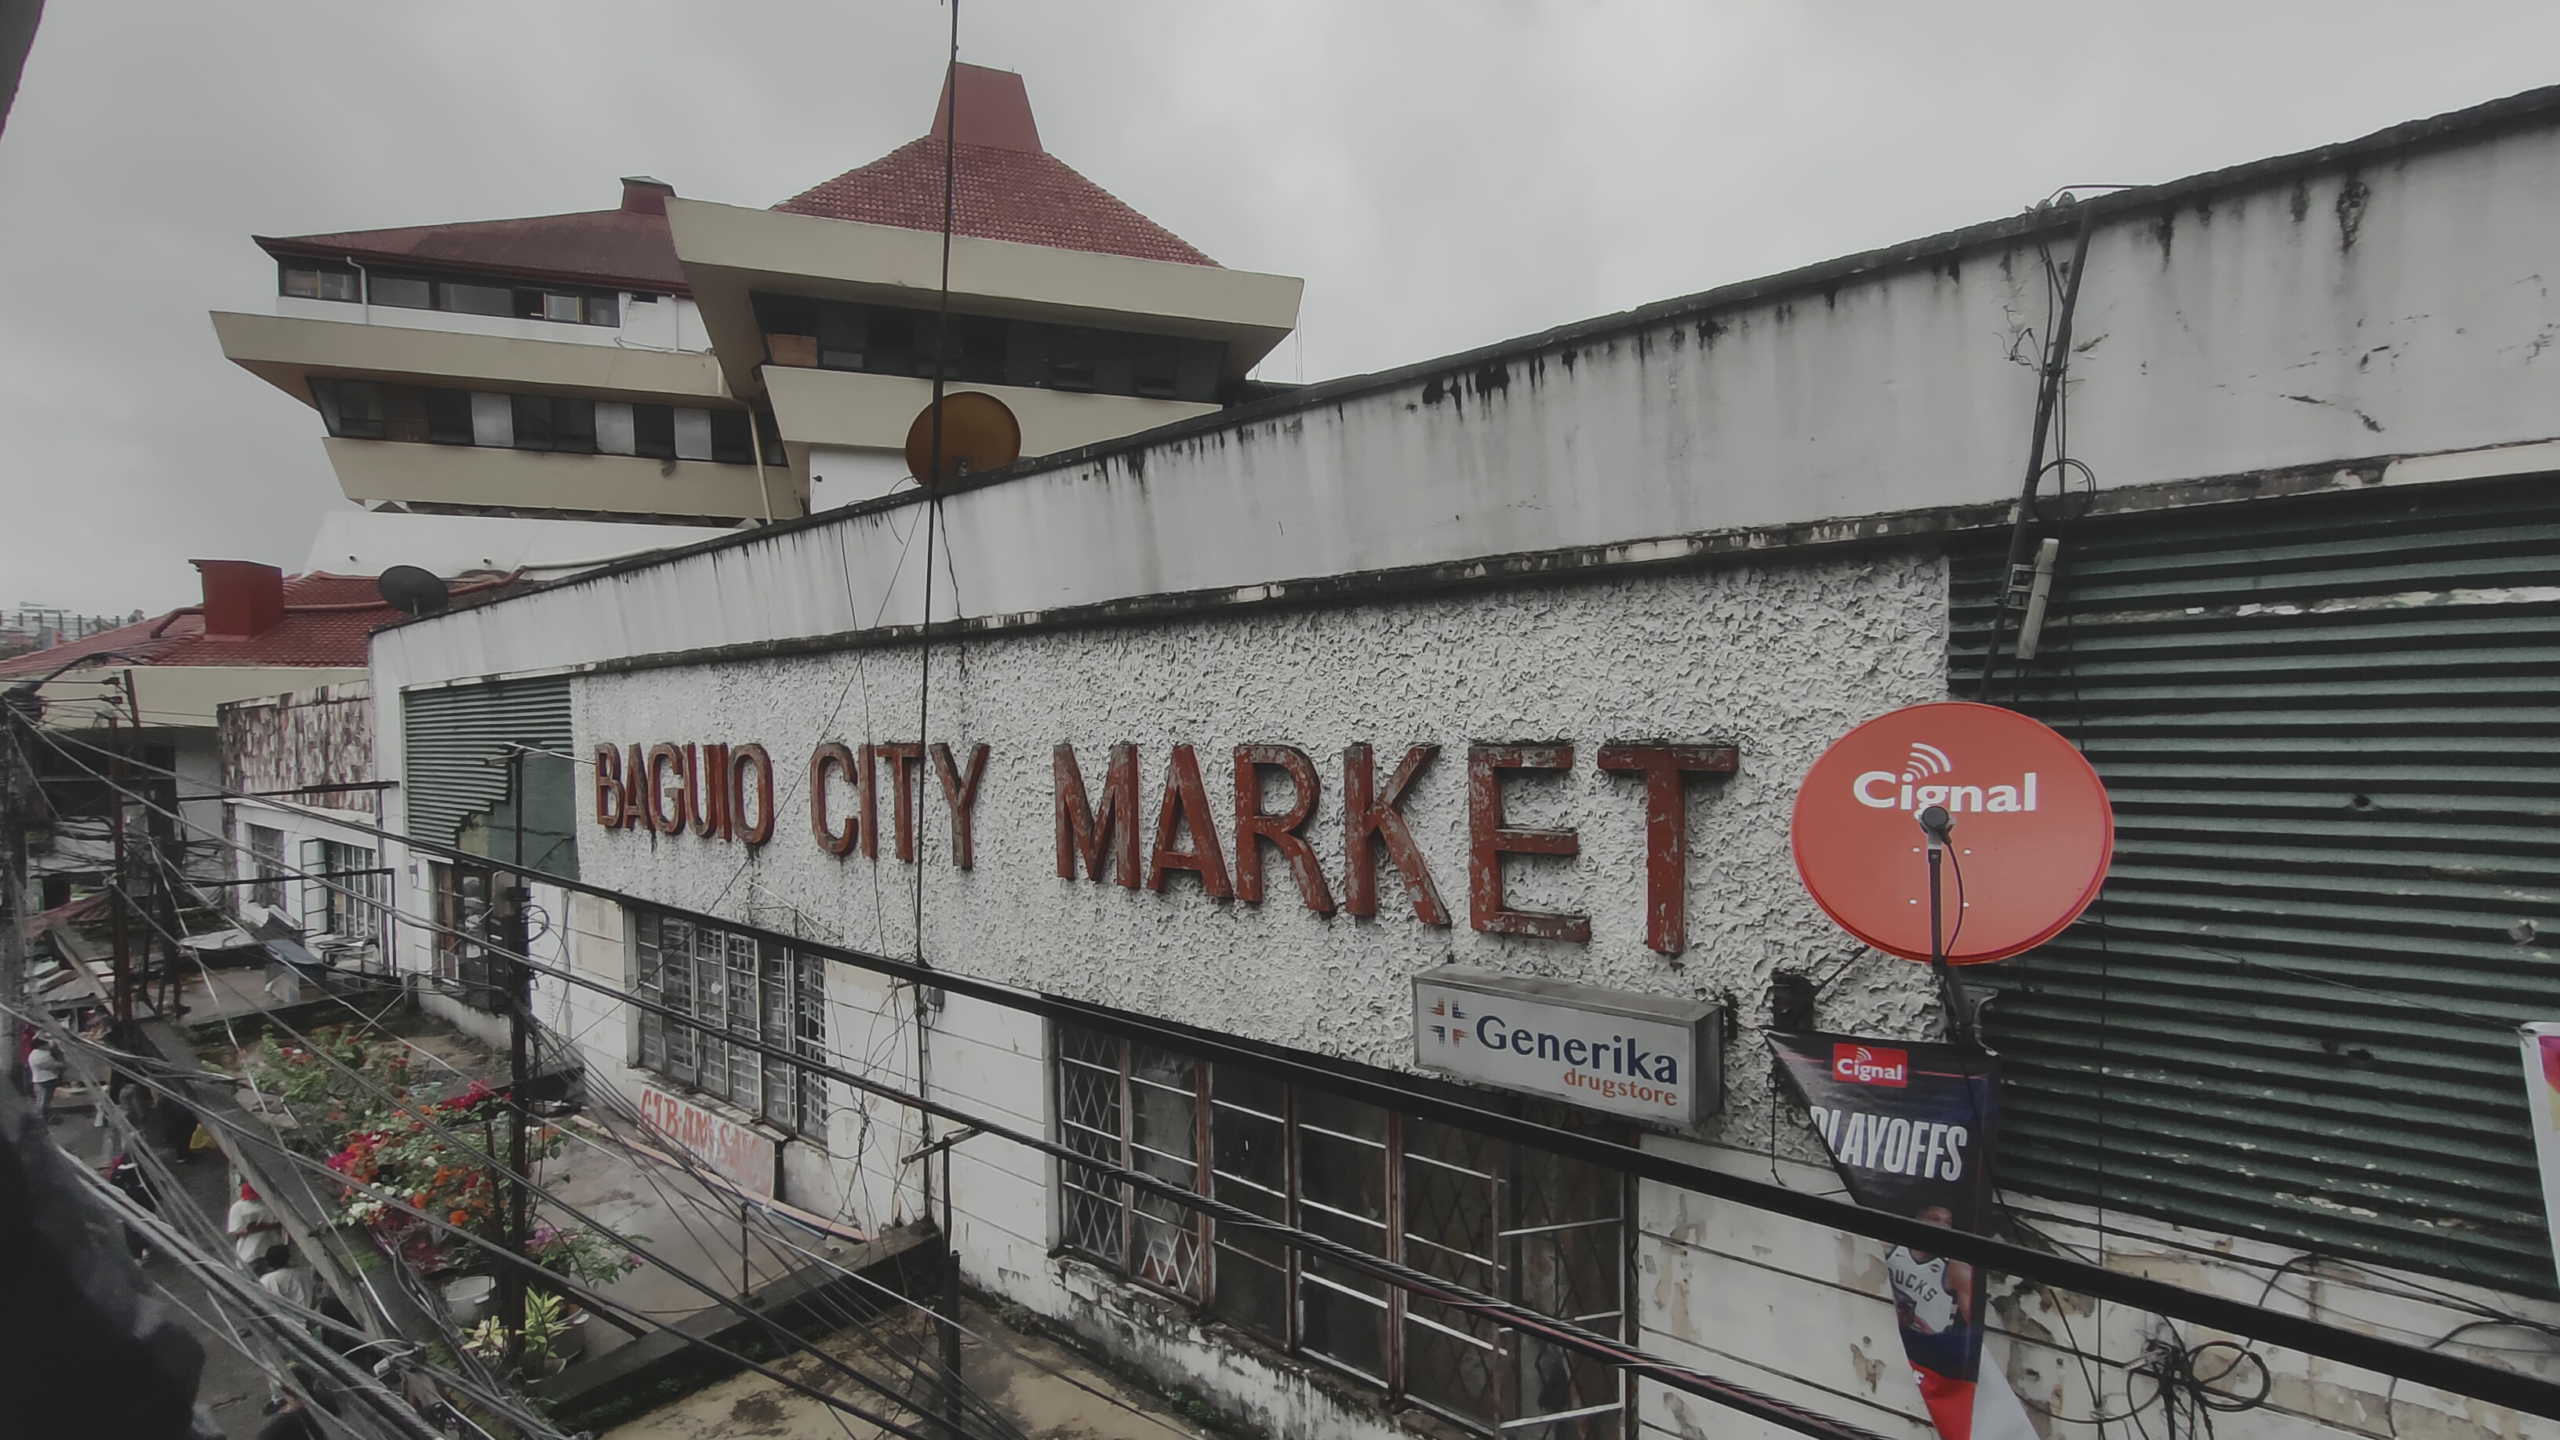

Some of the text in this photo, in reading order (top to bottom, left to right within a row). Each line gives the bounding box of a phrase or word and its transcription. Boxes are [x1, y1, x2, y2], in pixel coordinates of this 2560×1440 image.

[1853, 770, 2037, 821] Cignal
[594, 740, 1740, 955] BAGUIO CITY MARKET
[1476, 1015, 1678, 1085] Generika
[1837, 1057, 1903, 1082] Cignal
[1563, 1068, 1678, 1107] drugstore
